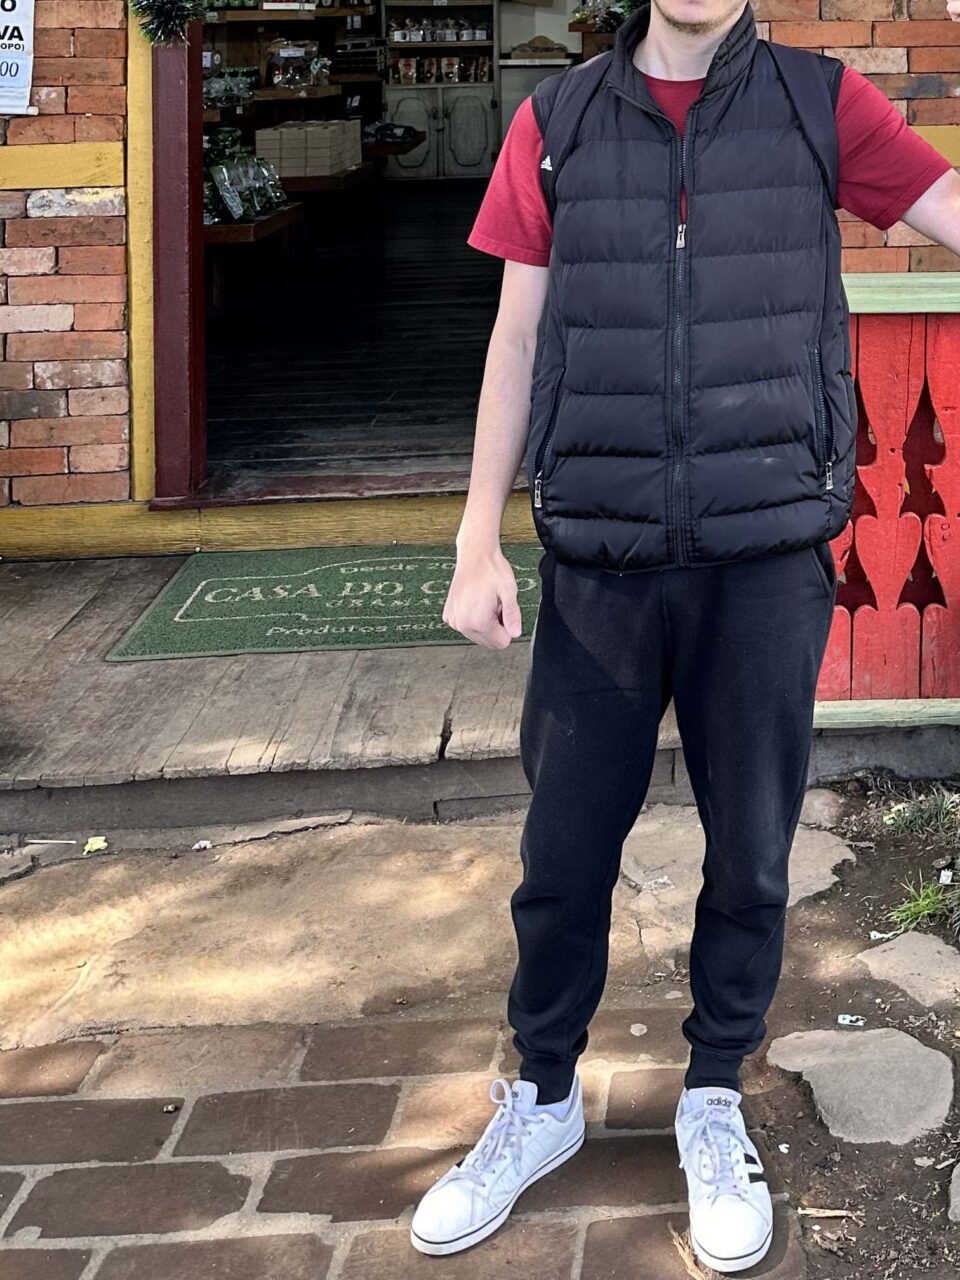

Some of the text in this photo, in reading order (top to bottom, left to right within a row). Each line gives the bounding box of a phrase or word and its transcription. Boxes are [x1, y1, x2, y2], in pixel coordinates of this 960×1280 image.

[340, 563, 418, 574] Desde
[204, 583, 322, 603] CASA
[338, 581, 404, 597] DO
[266, 624, 388, 636] Produtos
